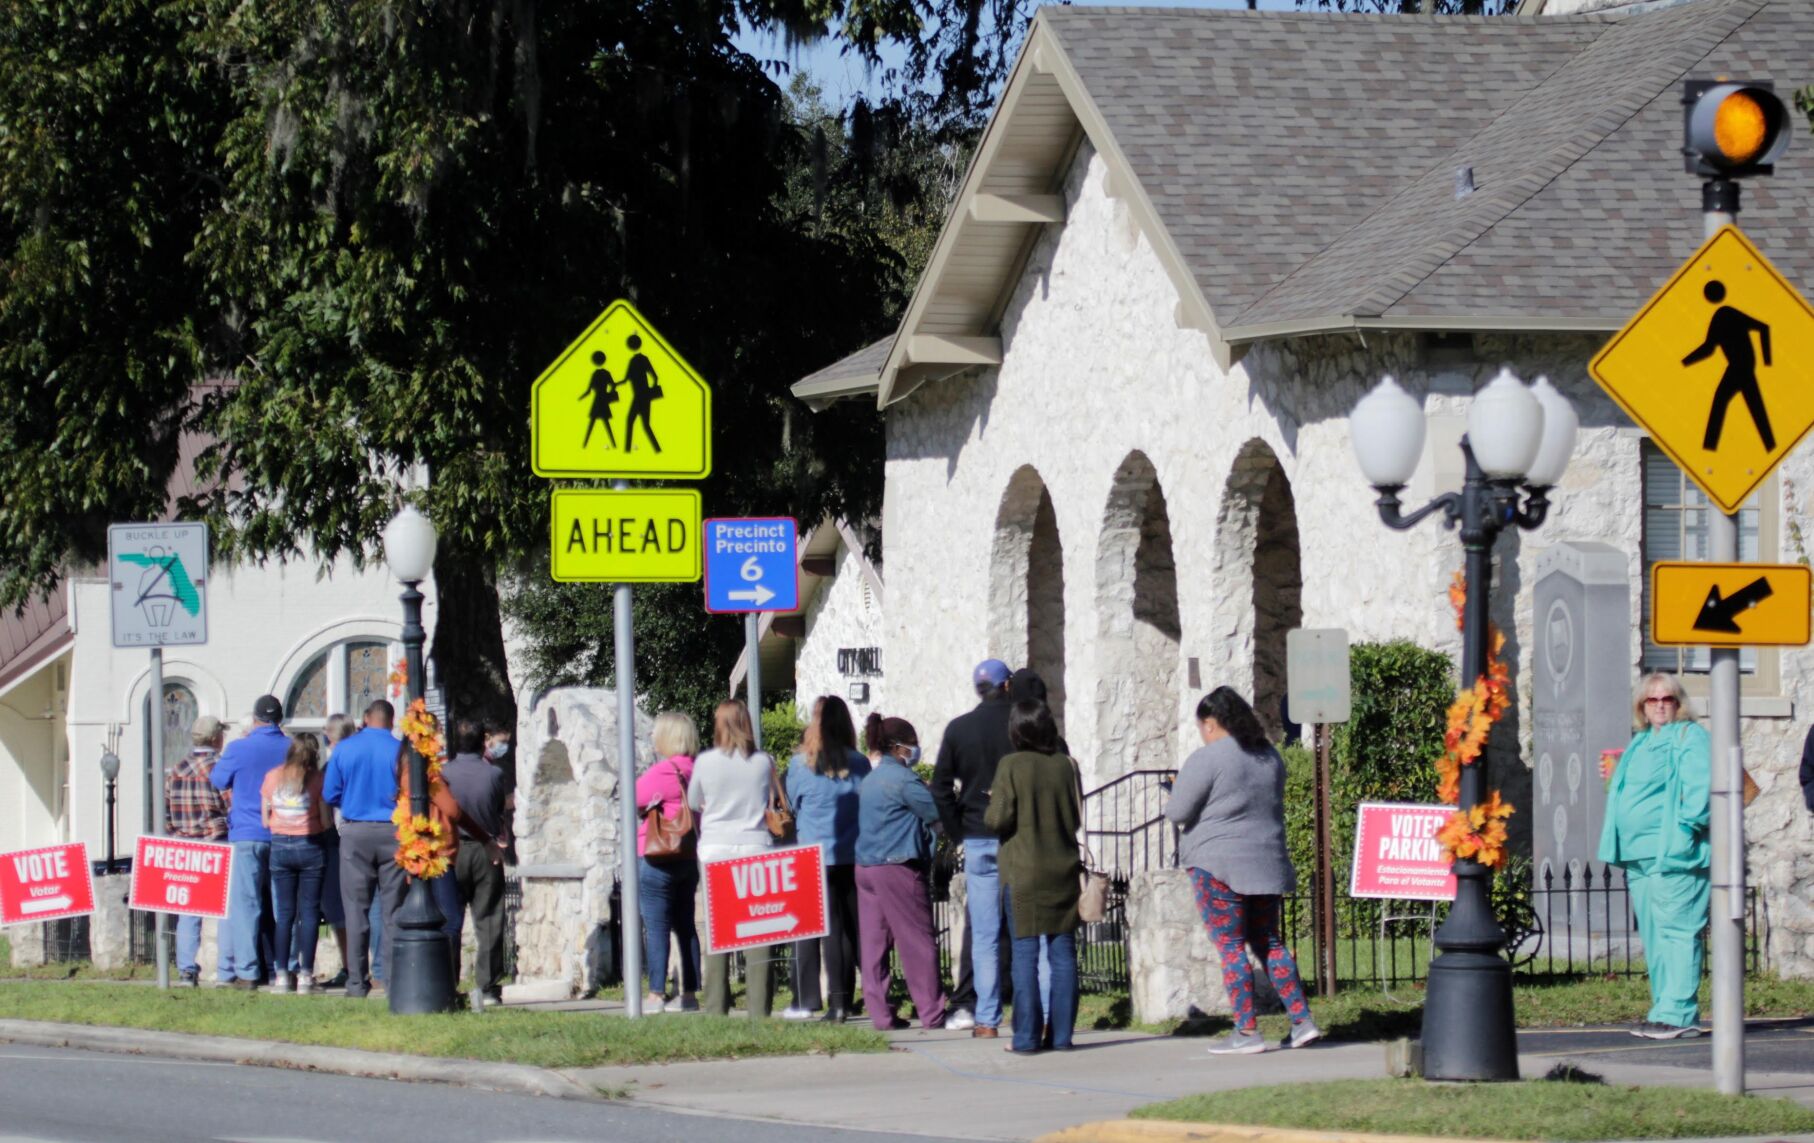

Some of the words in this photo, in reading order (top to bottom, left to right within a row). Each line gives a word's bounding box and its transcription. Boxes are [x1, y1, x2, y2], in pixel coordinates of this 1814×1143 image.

[125, 531, 168, 540] BUCKLE
[174, 530, 188, 538] UP
[567, 518, 686, 553] AHEAD
[716, 525, 784, 538] Precinct
[716, 540, 786, 554] Precinto
[740, 556, 764, 581] 6
[149, 632, 168, 640] THE
[175, 631, 196, 640] LAW
[1378, 837, 1442, 861] PARKIN
[13, 851, 69, 883] VOTE
[143, 845, 223, 874] PRECINCT
[163, 872, 200, 883] Precinto
[731, 857, 798, 899] VOTE
[1378, 876, 1400, 885] Para
[29, 885, 60, 897] Votar
[165, 885, 190, 905] 06
[748, 902, 786, 917] Votar
